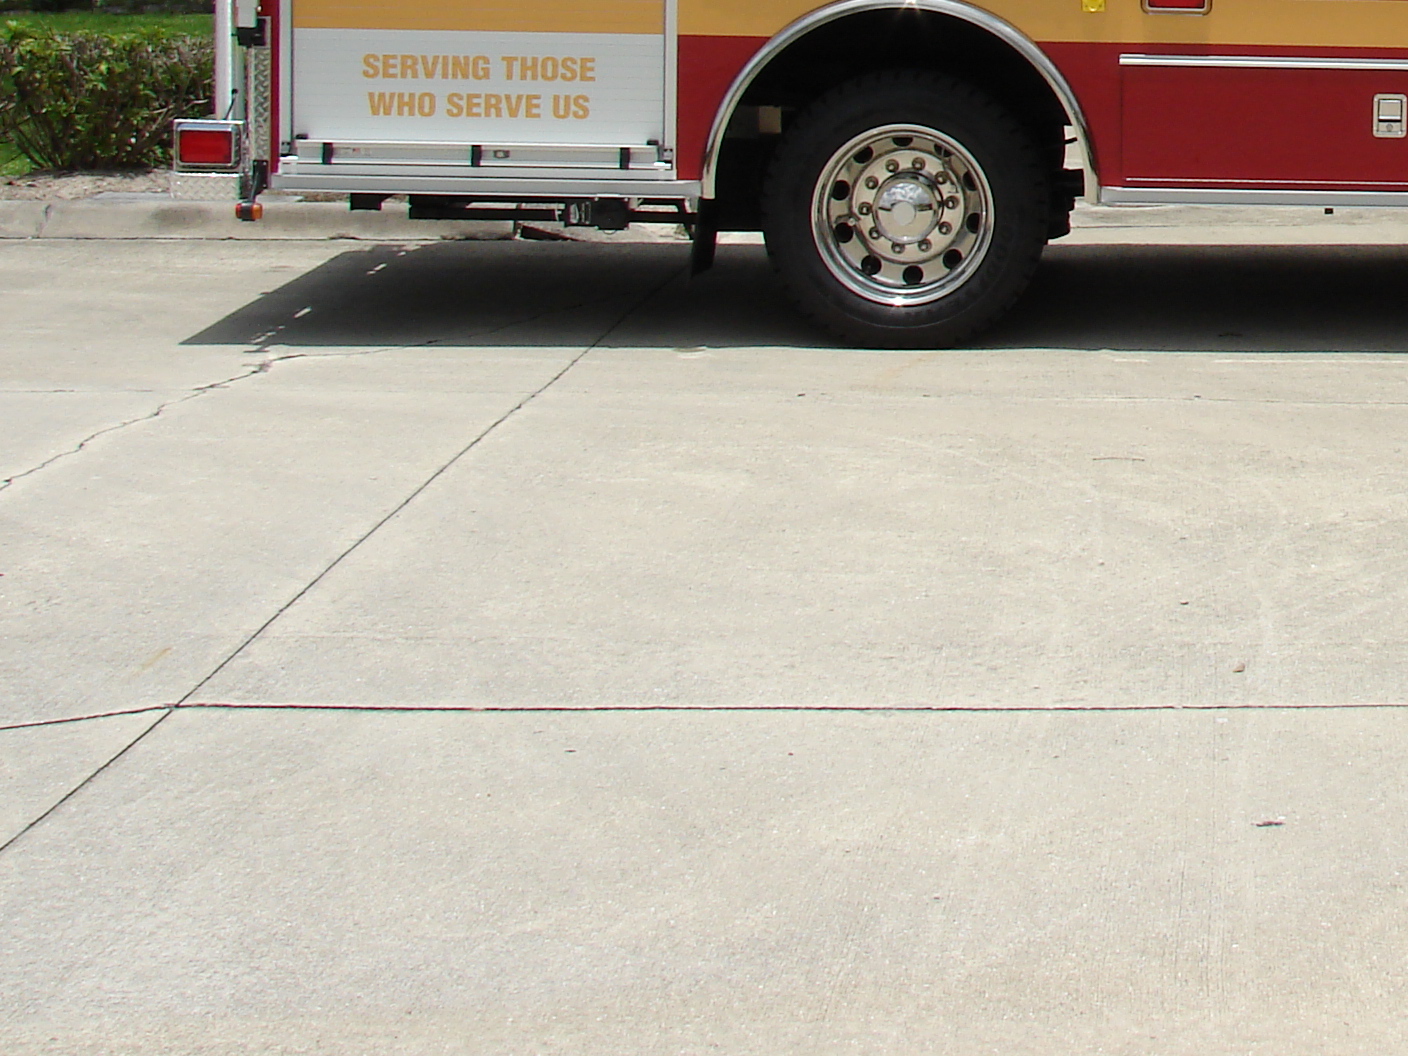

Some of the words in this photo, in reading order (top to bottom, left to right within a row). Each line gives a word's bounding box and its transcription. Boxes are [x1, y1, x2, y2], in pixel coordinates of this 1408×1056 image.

[362, 53, 491, 81] SERVING
[501, 56, 596, 82] THOSE
[368, 91, 437, 117] WHO
[446, 92, 542, 119] SERVE
[552, 94, 591, 120] US
